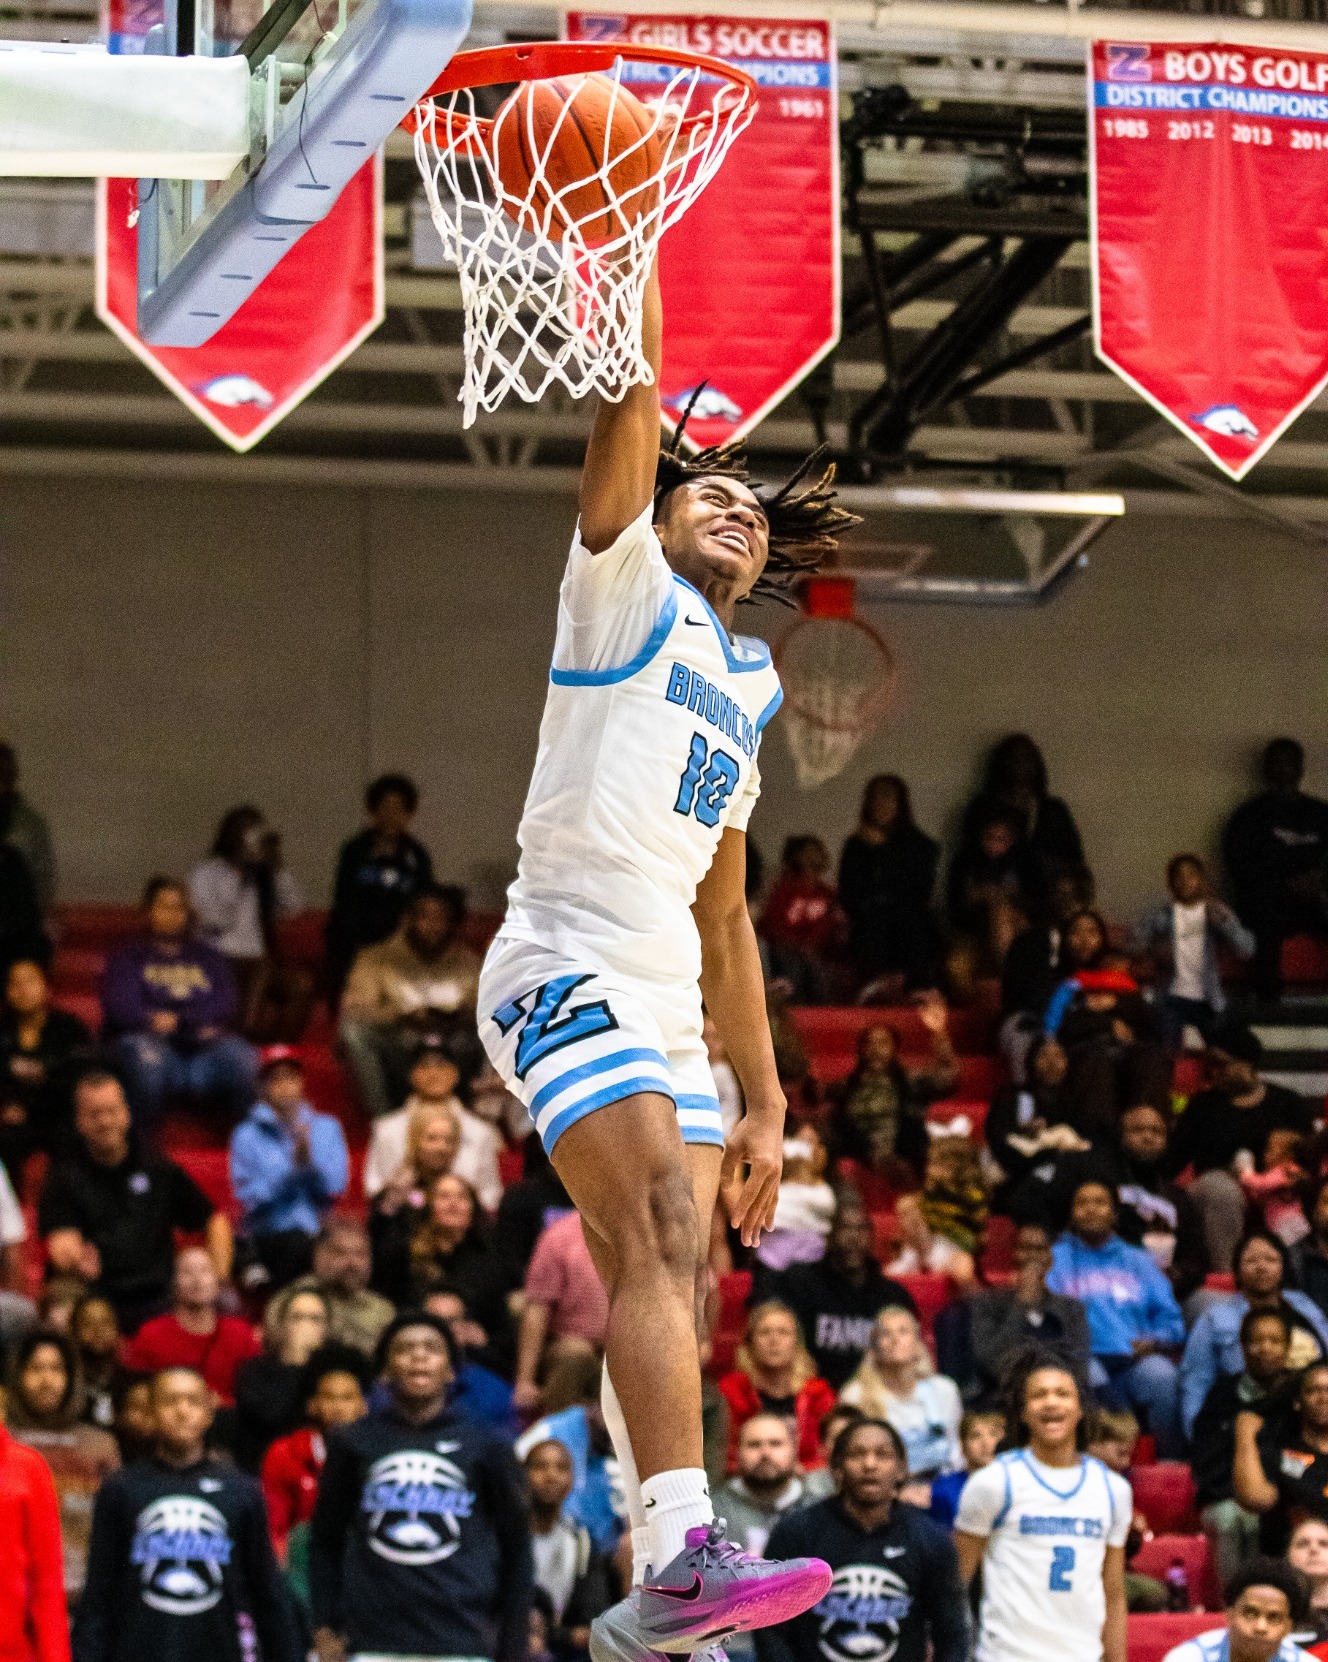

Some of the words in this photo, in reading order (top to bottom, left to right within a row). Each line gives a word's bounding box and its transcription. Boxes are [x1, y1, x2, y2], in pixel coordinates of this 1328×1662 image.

[630, 20, 712, 54] GIRLS
[715, 24, 824, 59] SOCCER
[1164, 50, 1247, 84] BOYS
[1252, 57, 1328, 92] GOLF
[1106, 84, 1203, 109] DISTRICT
[1207, 86, 1328, 120] CHAMPIONS
[1103, 118, 1149, 139] 1985
[1167, 120, 1215, 140] 2012
[1231, 123, 1273, 146] 2013
[665, 661, 756, 761] BRONCOS
[673, 730, 740, 829] 10
[1049, 1545, 1076, 1593] 2
